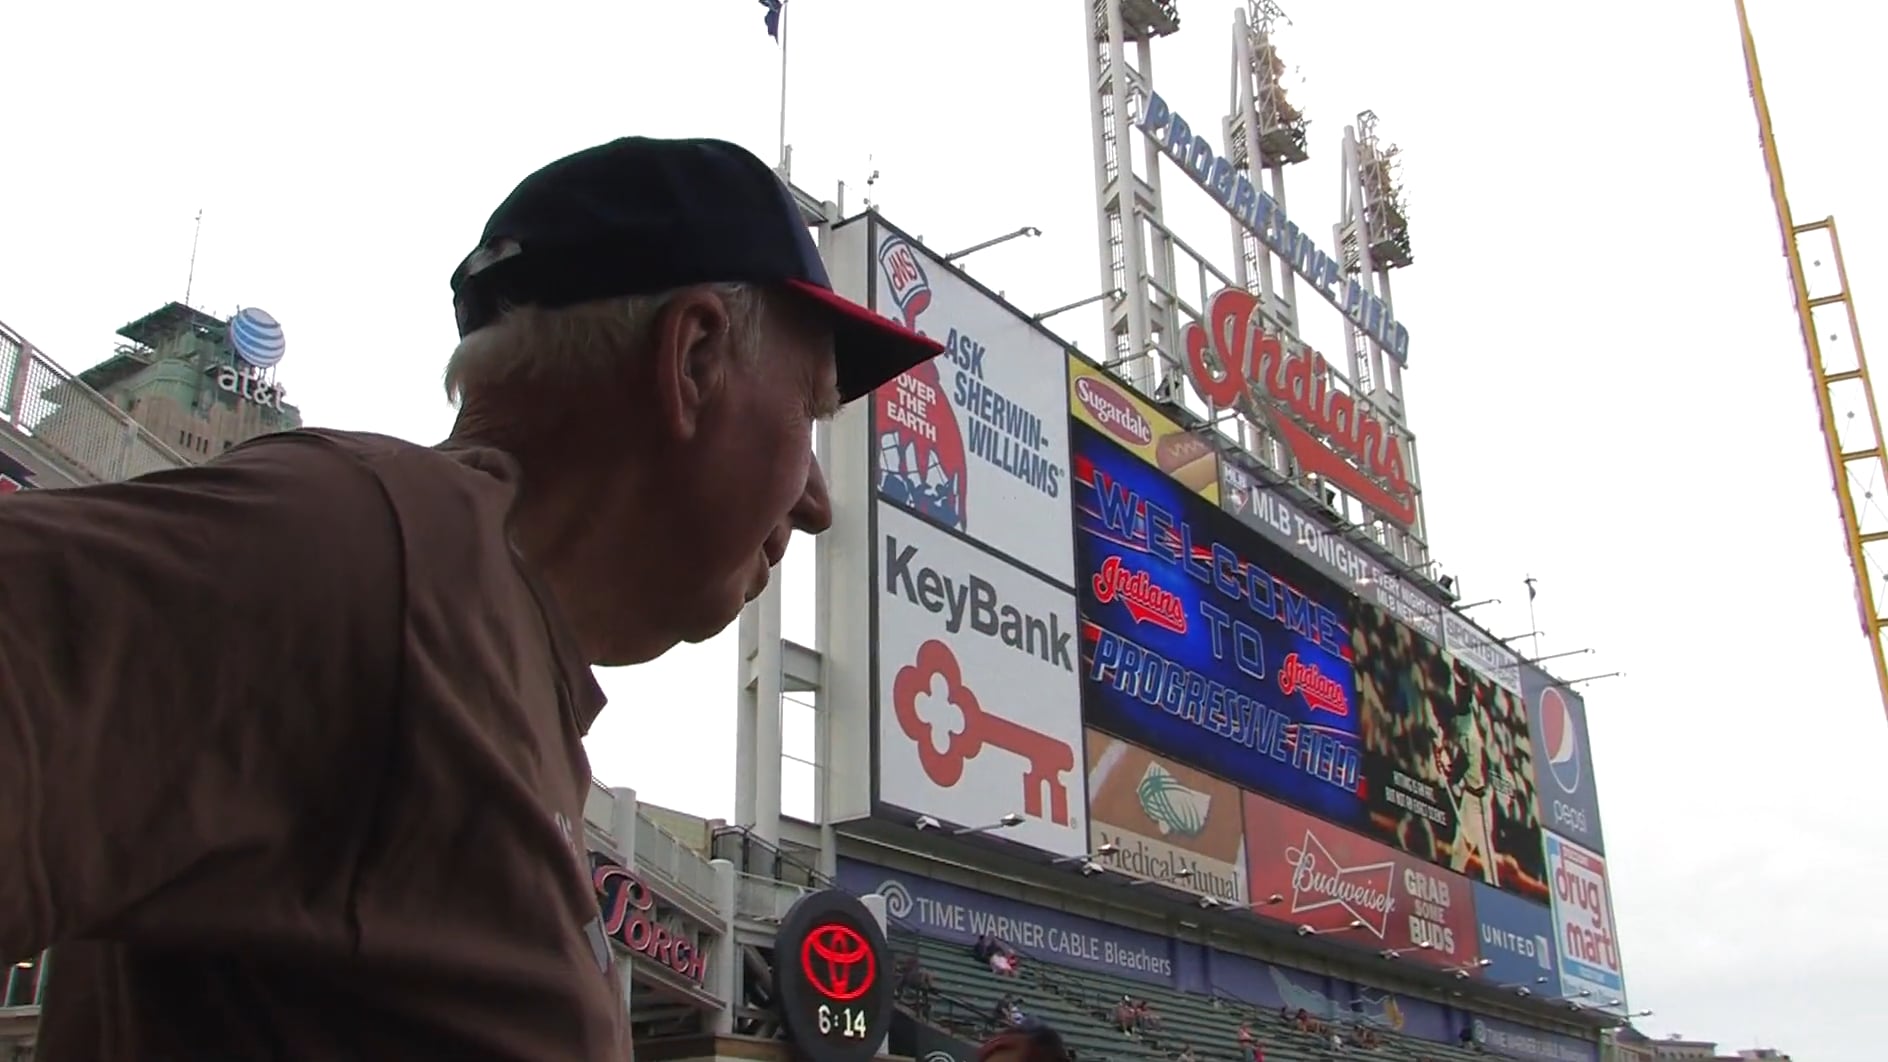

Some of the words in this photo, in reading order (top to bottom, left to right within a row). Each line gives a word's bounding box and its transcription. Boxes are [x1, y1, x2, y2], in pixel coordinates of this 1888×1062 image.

[1136, 89, 1347, 300] PROGRESSIVE
[1342, 278, 1409, 366] FIELD
[945, 327, 986, 380] ASK
[217, 364, 286, 413] at&t
[887, 400, 937, 442] EARTH
[892, 373, 937, 405] OVER
[896, 386, 927, 419] THE
[953, 371, 1049, 452] SHERWIN-
[1075, 377, 1150, 444] Sugardale
[1182, 287, 1413, 515] Indians
[967, 416, 1060, 499] WILLIAMS
[1092, 469, 1341, 657] WELCOME
[1251, 485, 1292, 537] MLB
[1293, 512, 1368, 584] TONIGHT
[885, 534, 1074, 673] KeyBank
[1091, 555, 1188, 634] Indians
[1396, 600, 1438, 636] NETRK
[1200, 599, 1265, 679] TO
[1091, 631, 1291, 762] PROGRESSIVE
[1293, 722, 1361, 793] FIELD
[1277, 652, 1349, 717] Indians
[1553, 799, 1588, 833] pepsi
[1099, 831, 1177, 884] Medical
[1178, 856, 1240, 902] Mutual
[1284, 846, 1396, 914] Budweiser
[1403, 867, 1451, 908] GRAB
[1555, 843, 1602, 928] drug
[916, 896, 966, 932] TIME
[968, 909, 1045, 949] WARNER
[1047, 927, 1100, 962] CABLE
[1103, 940, 1172, 977] Bleachers
[1408, 914, 1455, 955] BUDS
[1414, 898, 1446, 924] SOME
[1481, 922, 1535, 958] UNITED
[1566, 920, 1618, 971] mart
[817, 1004, 867, 1039] 6:14
